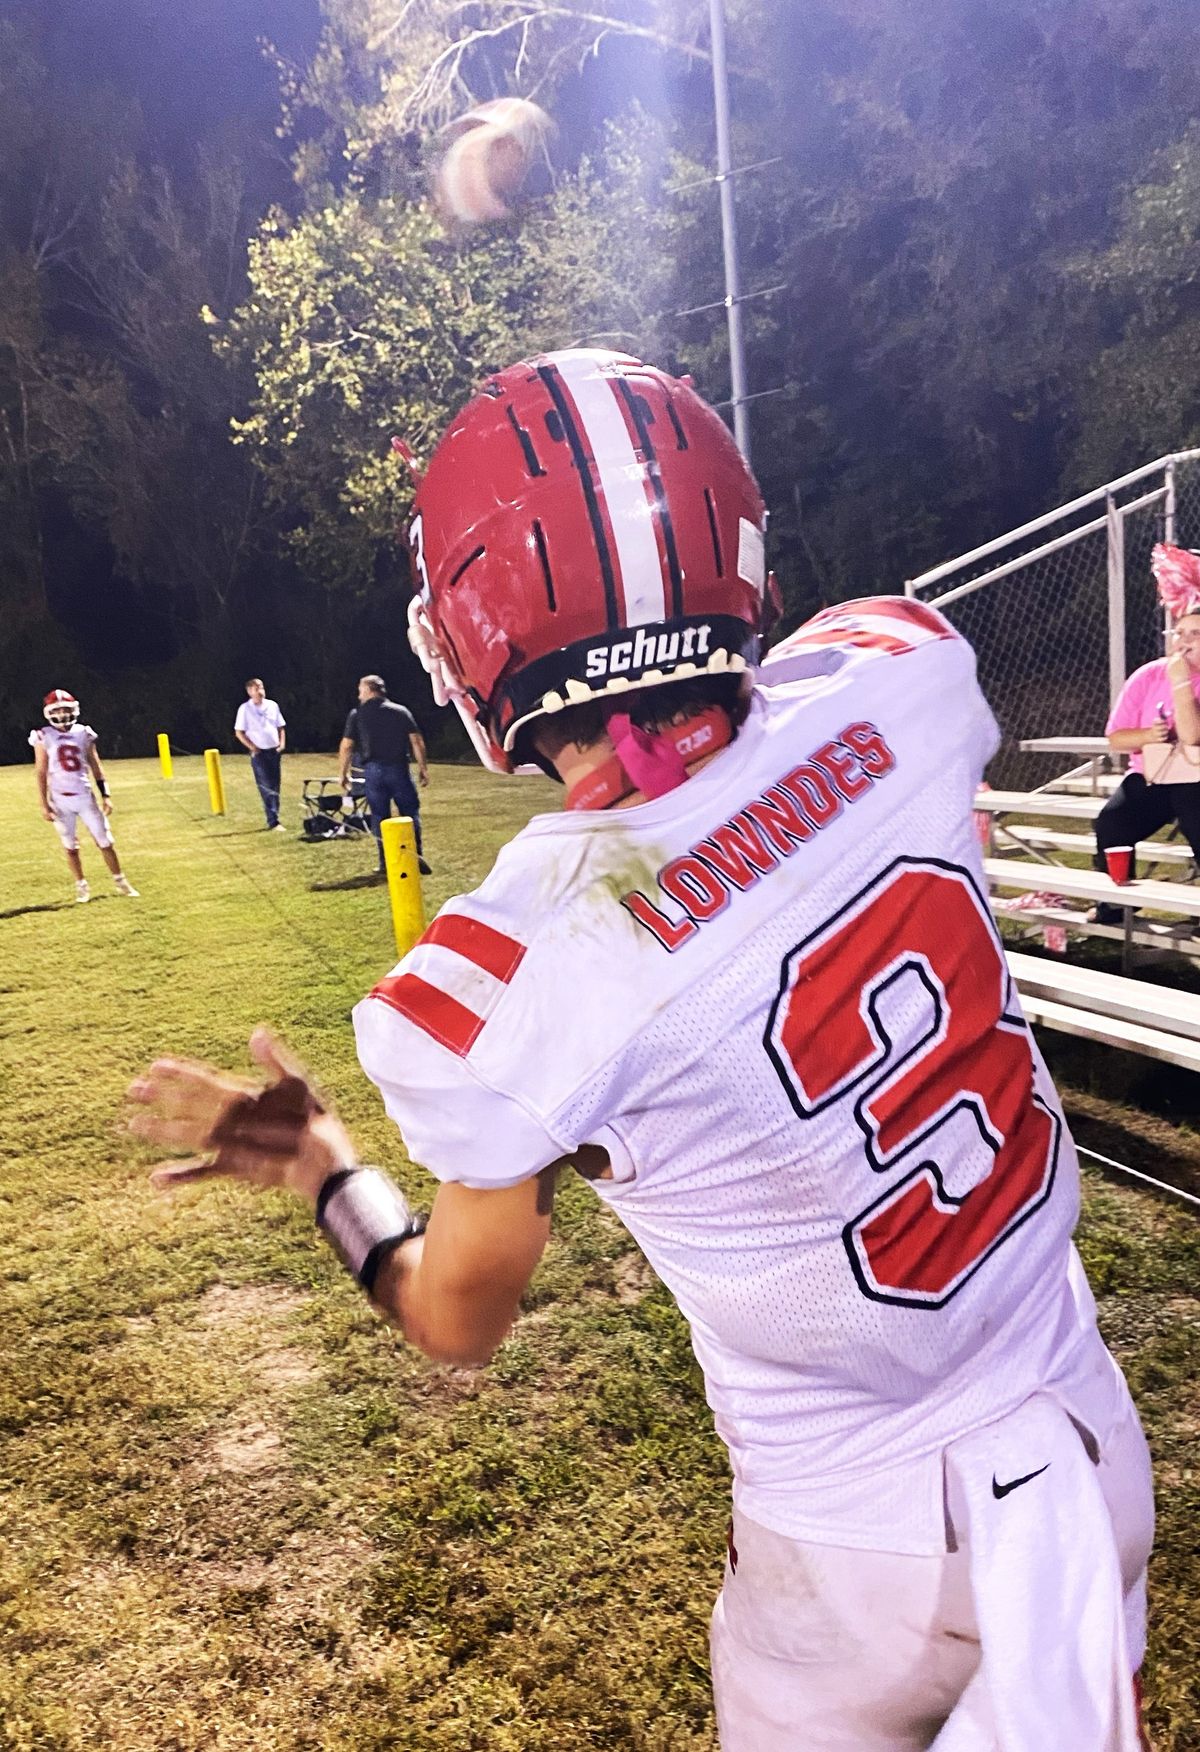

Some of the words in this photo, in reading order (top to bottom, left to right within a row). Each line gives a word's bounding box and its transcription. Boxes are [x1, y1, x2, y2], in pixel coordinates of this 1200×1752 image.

[586, 625, 712, 678] schutt
[57, 744, 81, 772] 6
[620, 721, 896, 953] LOWNDES
[762, 855, 1062, 1310] 3
